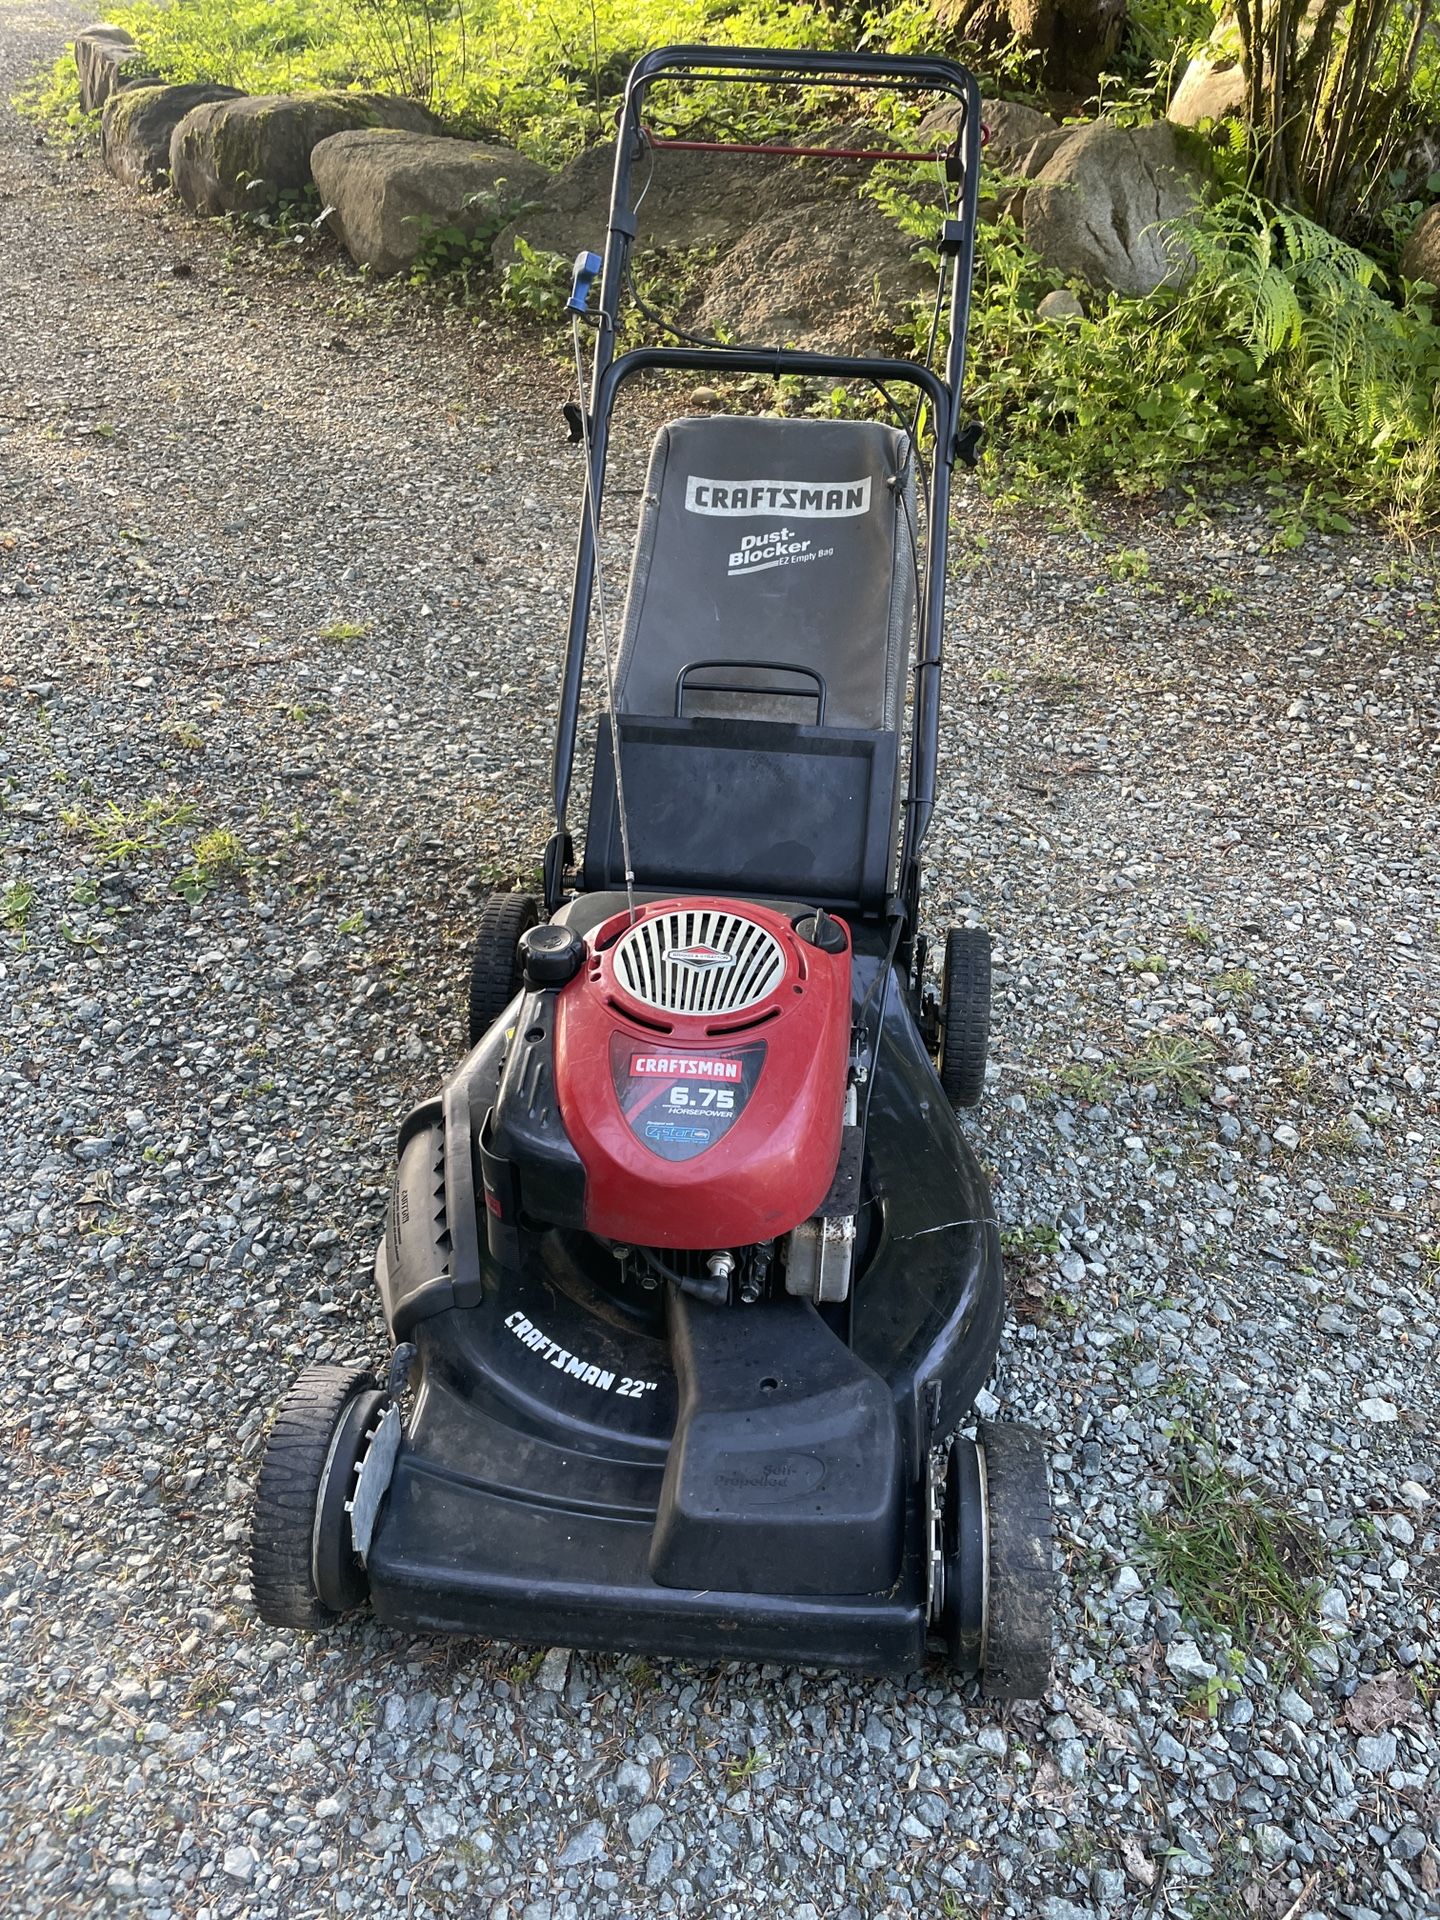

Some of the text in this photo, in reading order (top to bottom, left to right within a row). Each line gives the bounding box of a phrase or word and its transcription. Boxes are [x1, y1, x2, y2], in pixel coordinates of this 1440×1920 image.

[695, 487, 864, 511] CRAFTSMAN
[741, 527, 795, 551] Dust-
[728, 540, 811, 567] Blocker
[778, 548, 834, 566] EZ Empty Bag
[635, 1058, 737, 1078] CRAFTSMAN
[669, 1086, 735, 1109] 6.75
[668, 1108, 734, 1118] HORSEPOWER
[504, 1311, 657, 1398] CRAFTSMAN 22"
